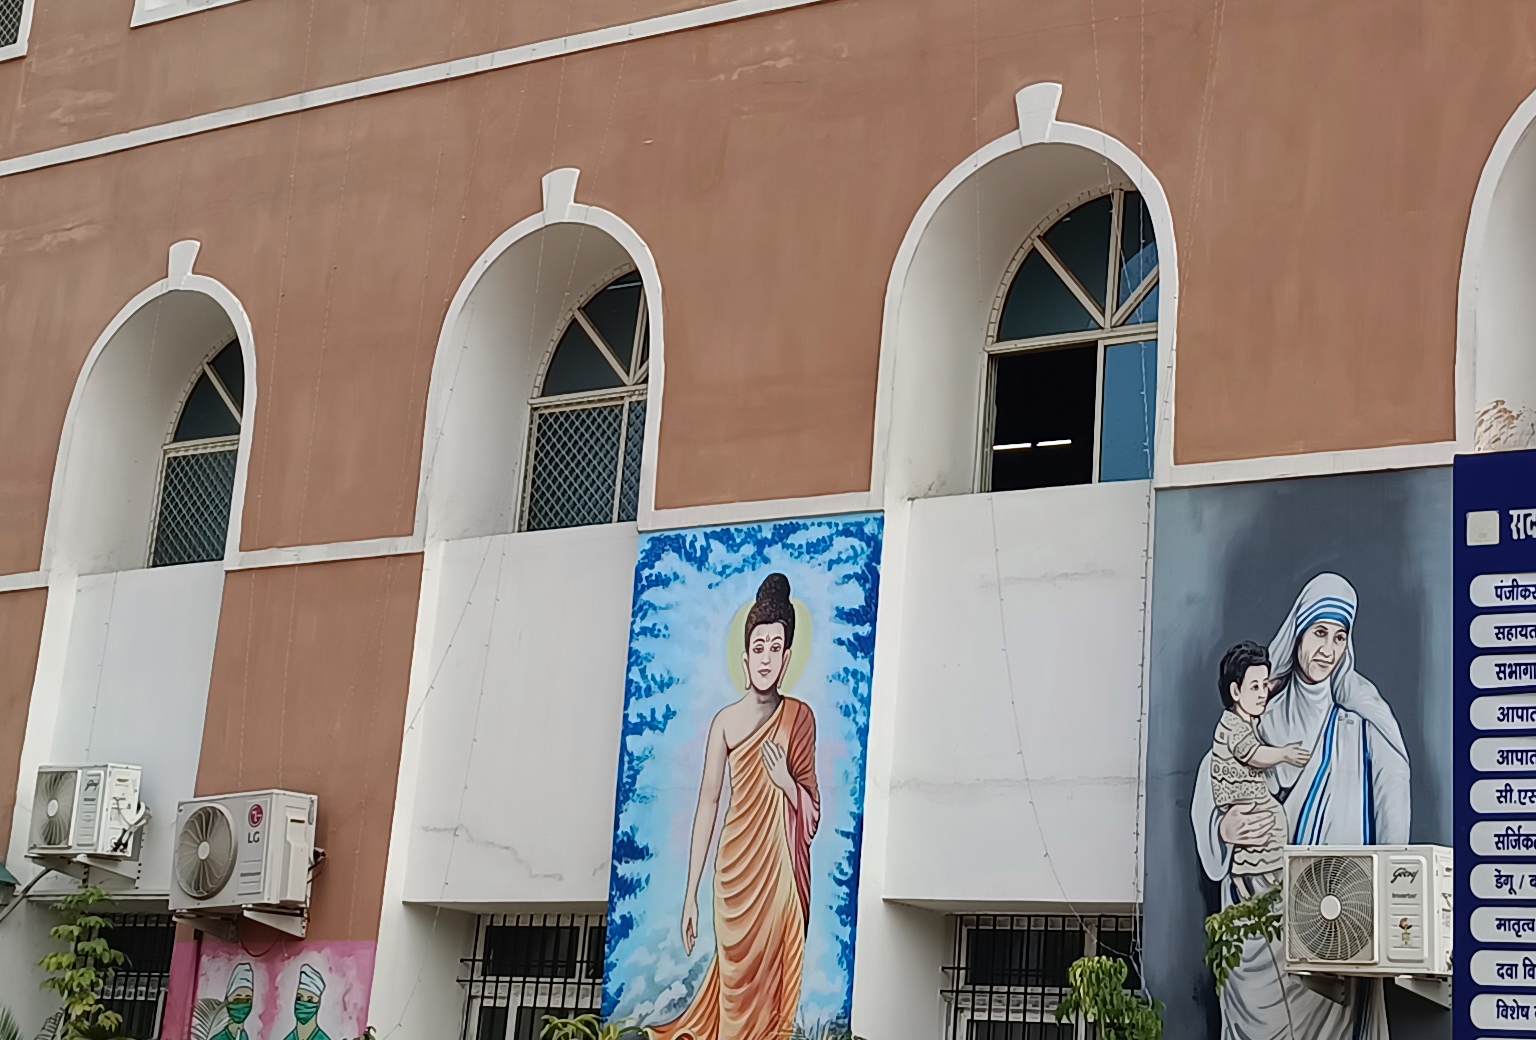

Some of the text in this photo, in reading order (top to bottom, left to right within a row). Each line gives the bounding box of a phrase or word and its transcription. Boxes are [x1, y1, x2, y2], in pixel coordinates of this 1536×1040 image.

[248, 831, 260, 843] LG
[1494, 869, 1517, 895] डेंगू
[1495, 918, 1535, 937] मातृत्व
[1496, 963, 1518, 979] दवा
[1496, 999, 1530, 1020] विशेष
